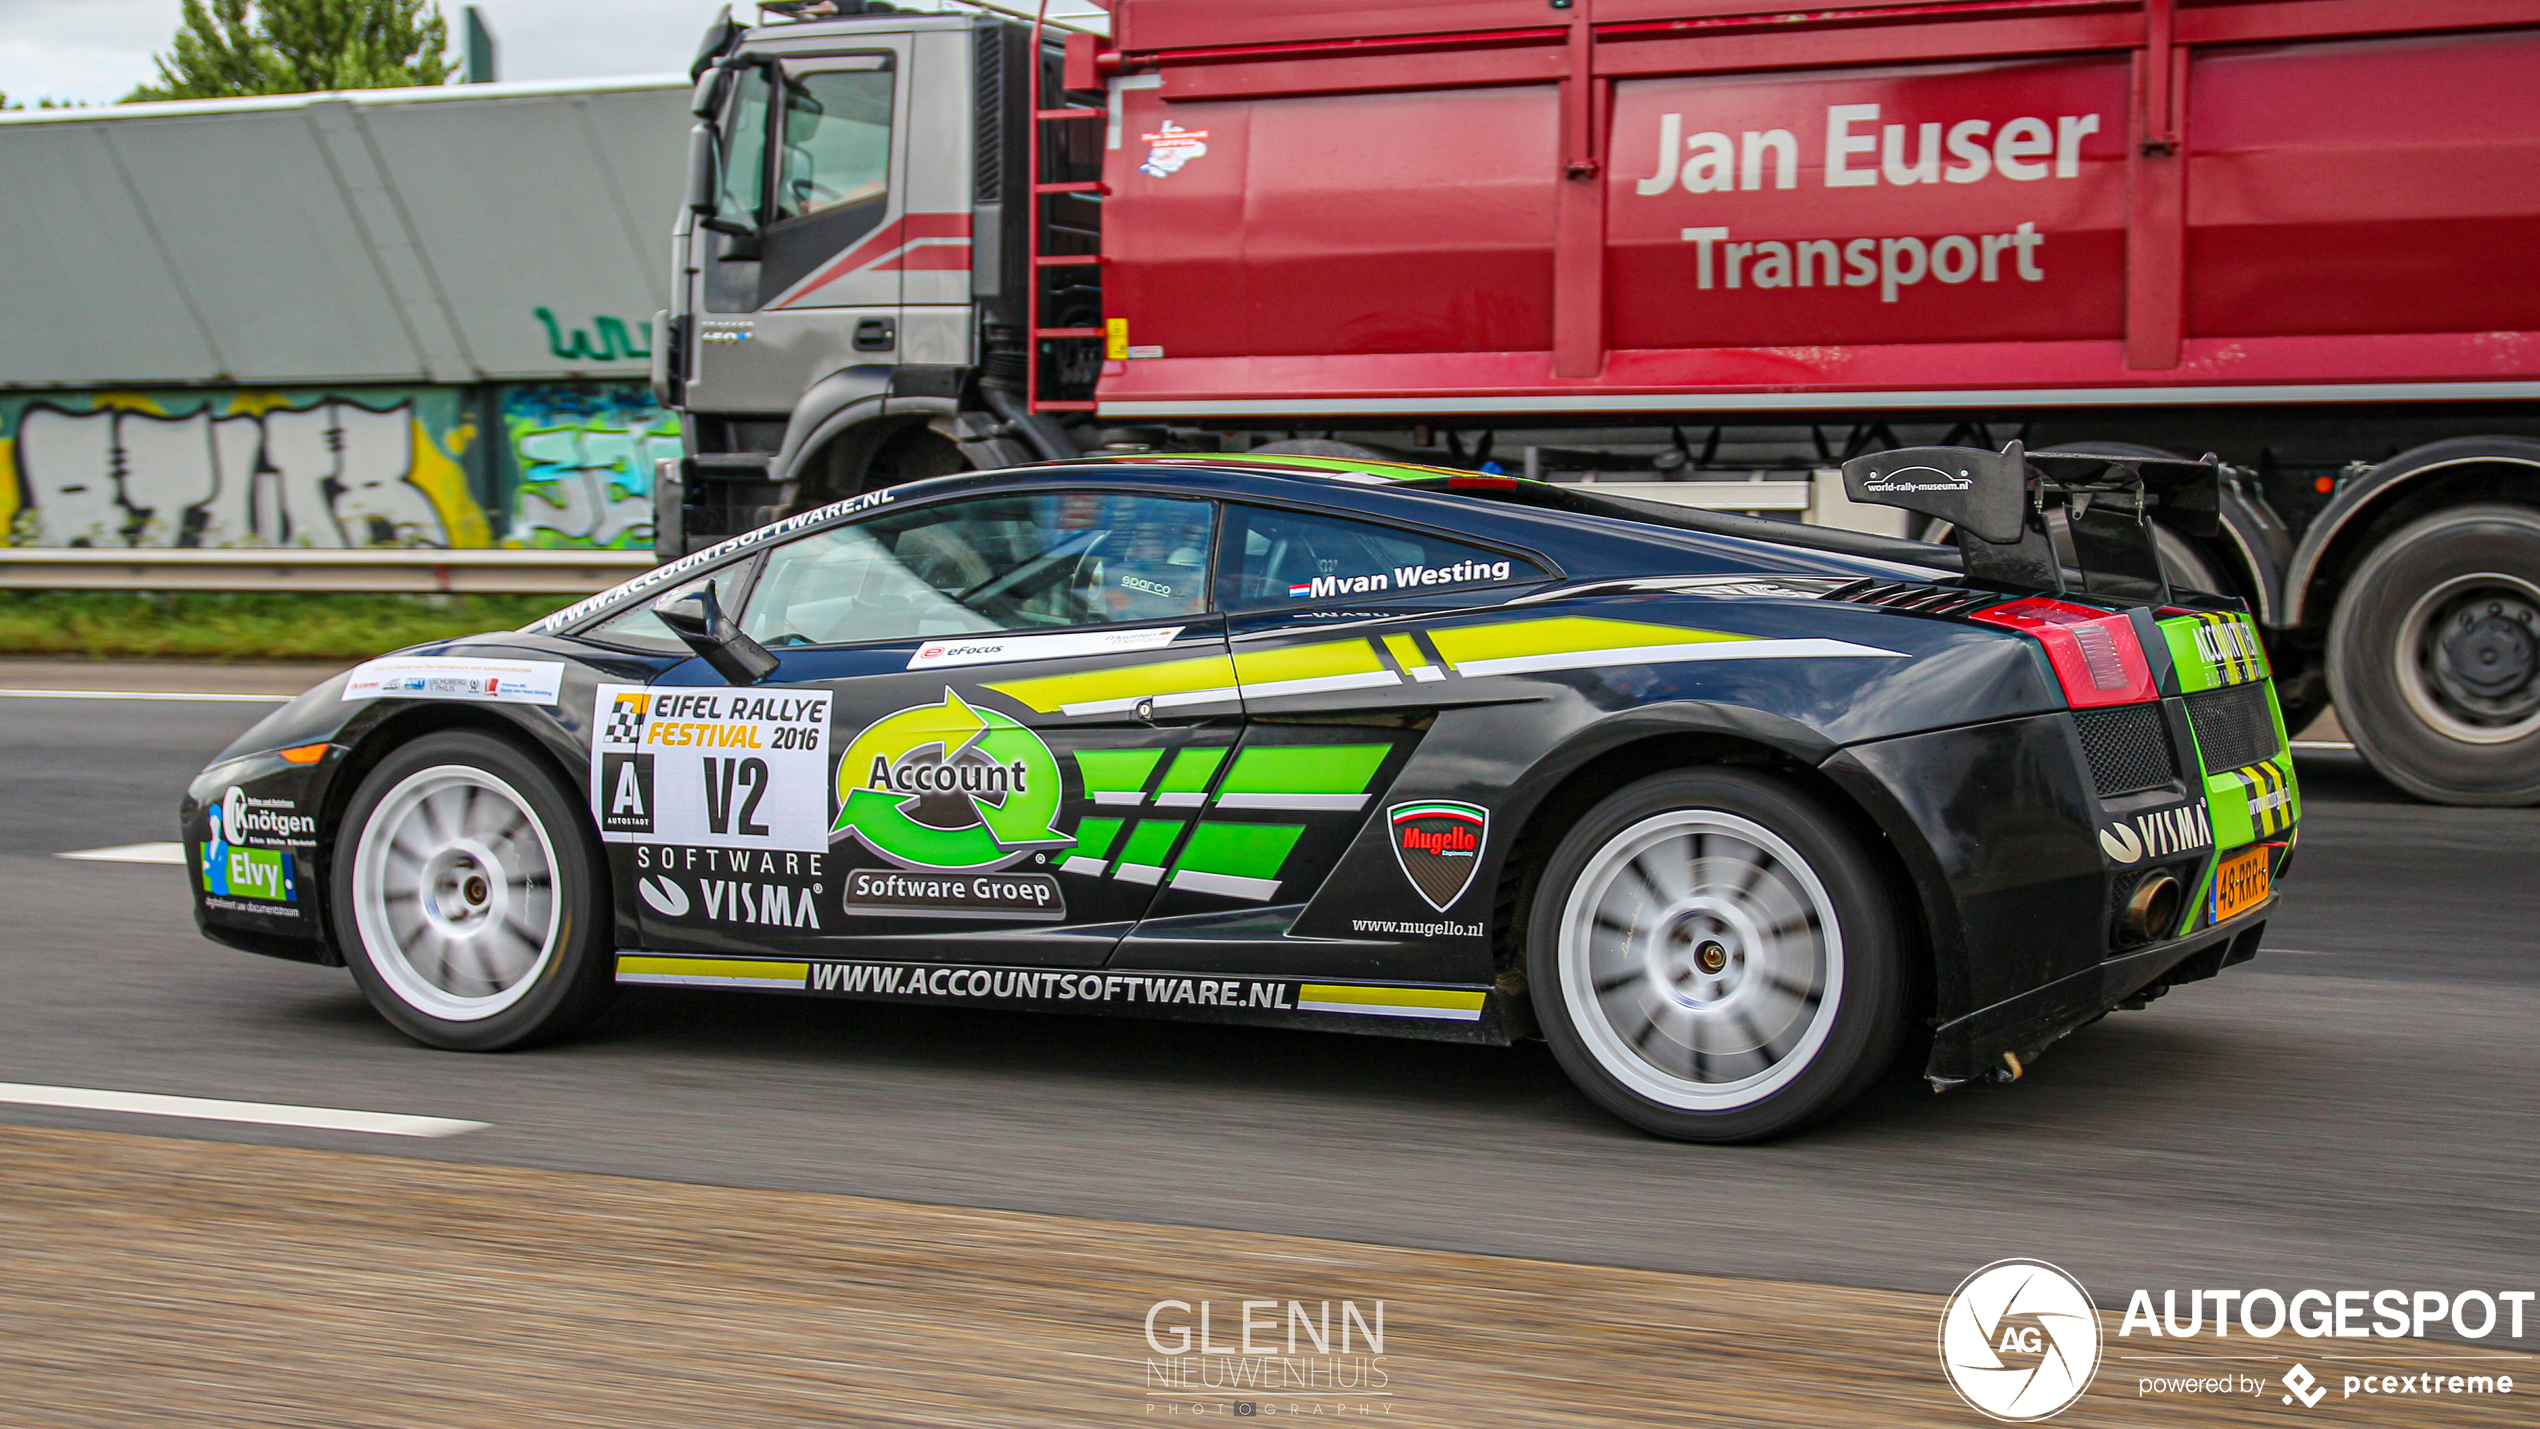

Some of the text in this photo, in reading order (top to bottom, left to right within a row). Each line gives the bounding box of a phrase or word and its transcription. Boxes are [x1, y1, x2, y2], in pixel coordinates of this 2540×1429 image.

[1636, 103, 2099, 195] Jan Euser
[1681, 222, 2044, 302] Transport
[1868, 481, 1969, 493] world-rally-museum.nl
[544, 488, 895, 632] WWW.ACCOUNTSOFTWARE.NL
[1121, 575, 1171, 596] sparco
[1310, 559, 1511, 599] Mvan Westing
[947, 645, 1003, 656] eFocus
[655, 694, 828, 723] EIFEL RALLYE
[646, 722, 820, 750] FESTIVAL 2016
[611, 761, 645, 815] A
[868, 755, 1026, 792] Account
[702, 756, 770, 837] V2
[234, 802, 316, 837] Knötgen
[606, 816, 649, 826] AUTOSTADT
[1402, 826, 1476, 855] Mugello
[231, 852, 278, 897] Elvy
[637, 846, 823, 876] SOFTWARE
[856, 875, 1050, 906] Software Groep
[2220, 852, 2267, 912] 48-RRR-6
[1352, 919, 1484, 937] www.mugello.nl
[812, 963, 1293, 1010] WWW.ACCOUNTSOFTWARE.NL
